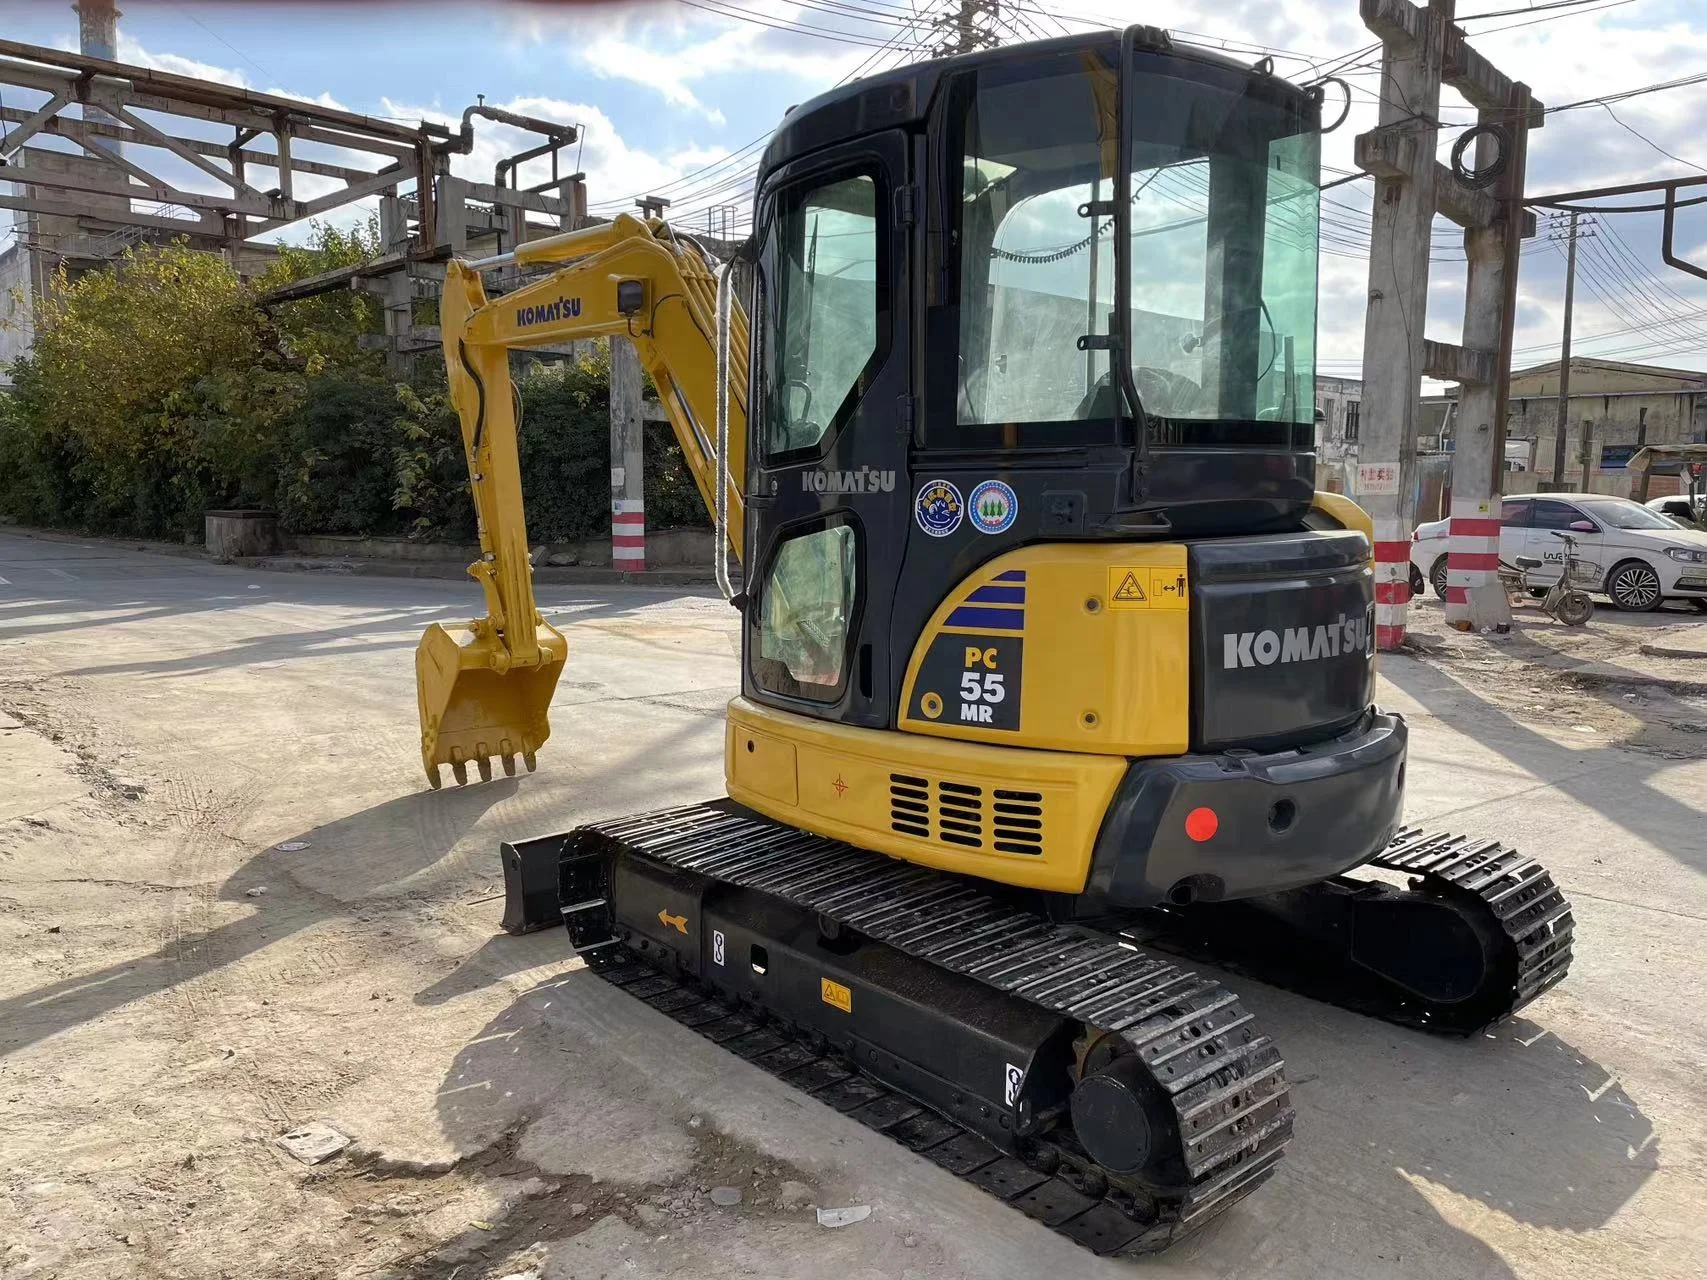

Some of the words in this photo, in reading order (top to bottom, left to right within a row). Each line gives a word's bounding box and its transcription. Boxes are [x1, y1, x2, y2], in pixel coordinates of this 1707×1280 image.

[517, 296, 582, 327] KOMATSU
[802, 466, 896, 493] KOMATSU
[1223, 613, 1366, 669] KOMATSU
[965, 647, 998, 669] PC
[960, 671, 1006, 703] 55
[961, 703, 993, 723] MR
